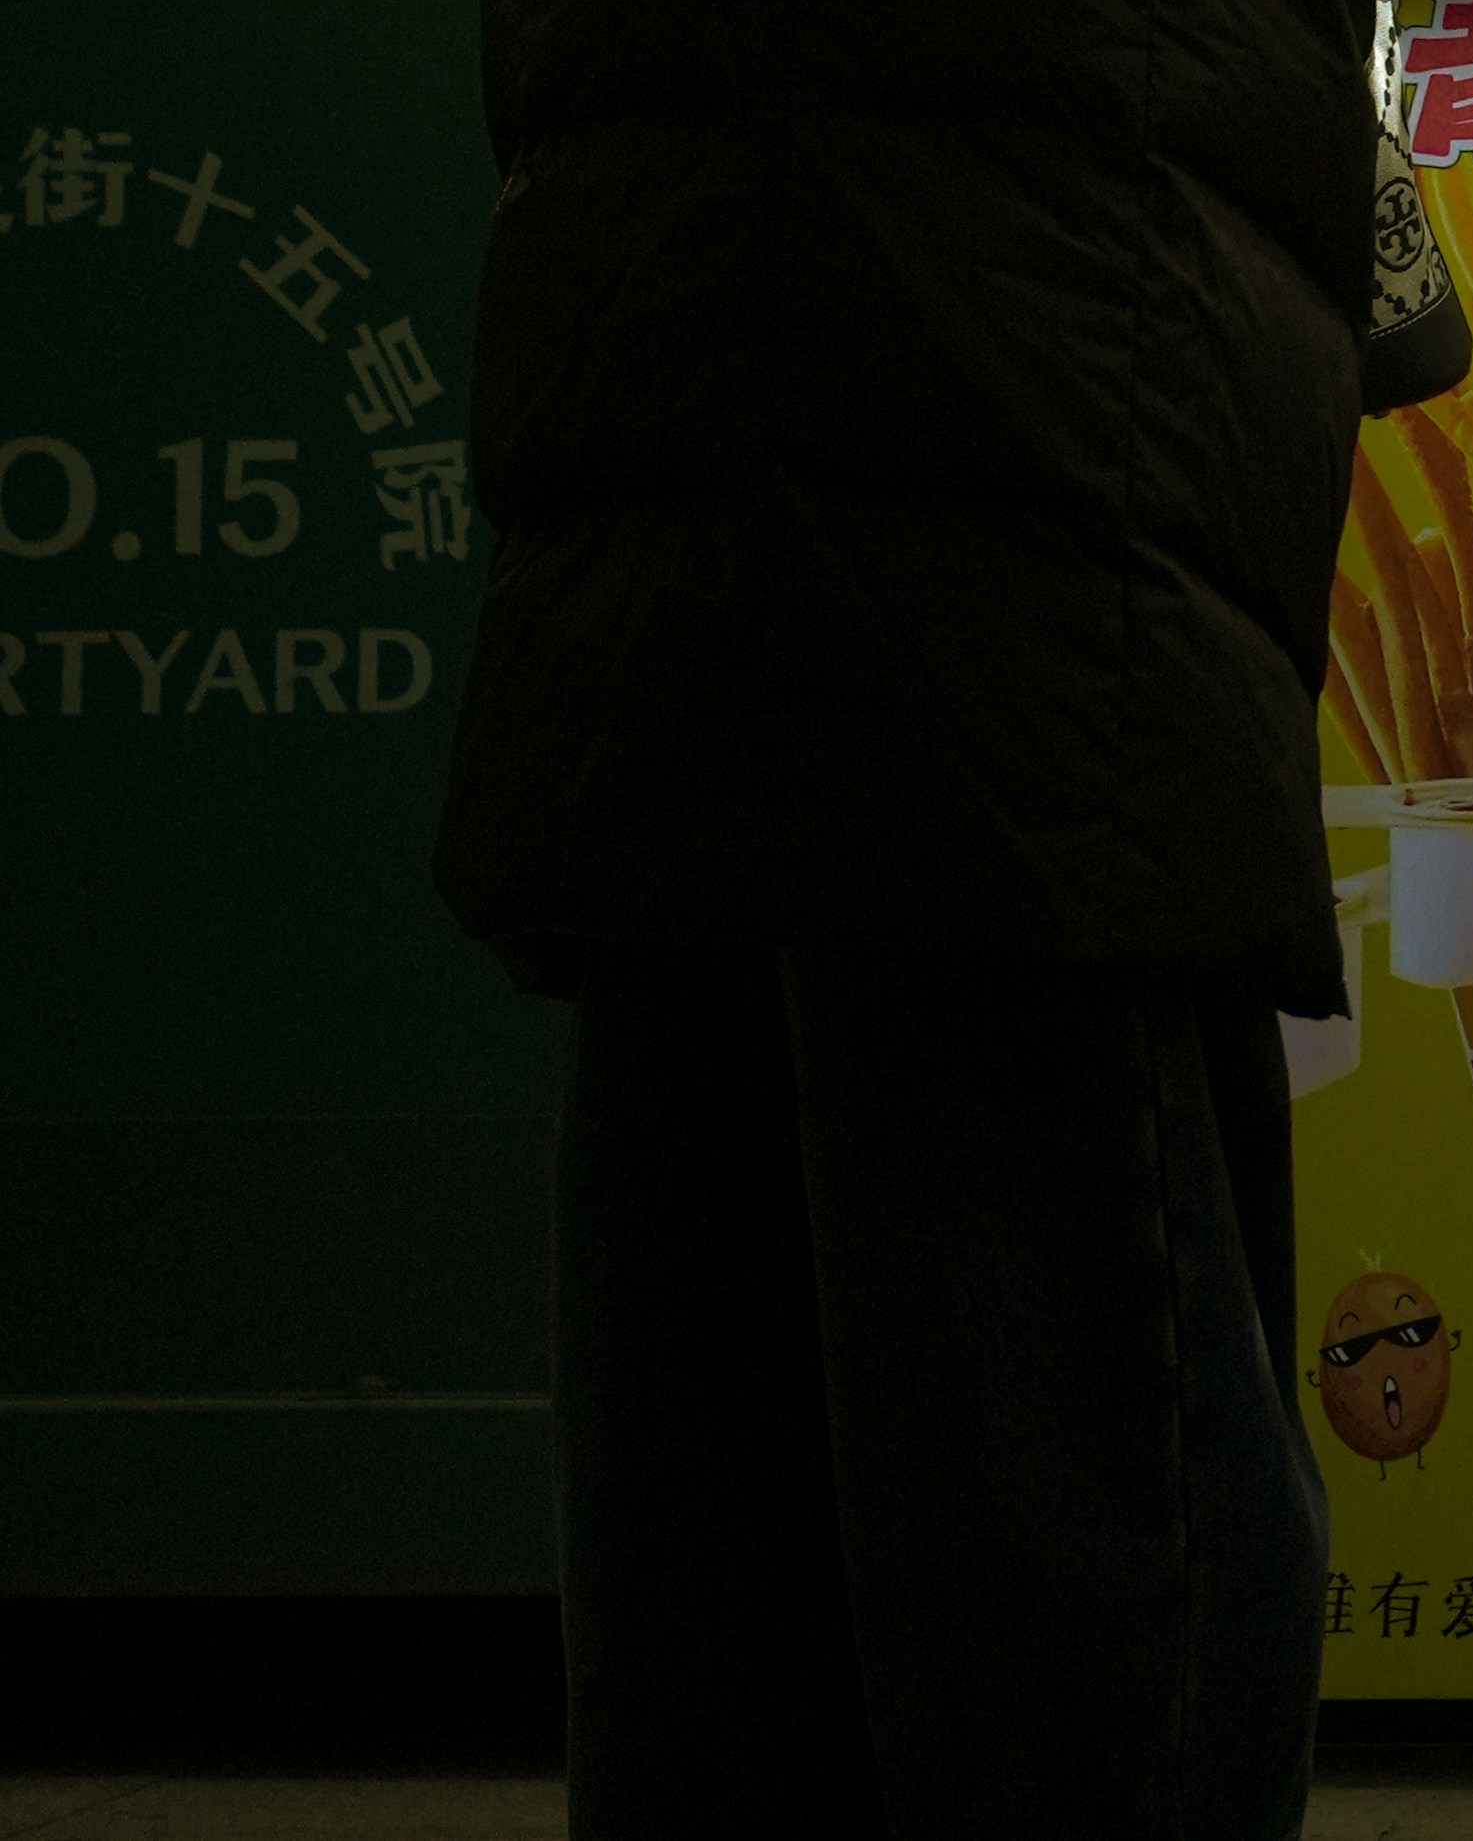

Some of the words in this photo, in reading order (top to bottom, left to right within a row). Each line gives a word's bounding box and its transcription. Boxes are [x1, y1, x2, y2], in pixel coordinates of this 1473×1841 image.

[0, 124, 473, 572] 街十五号院
